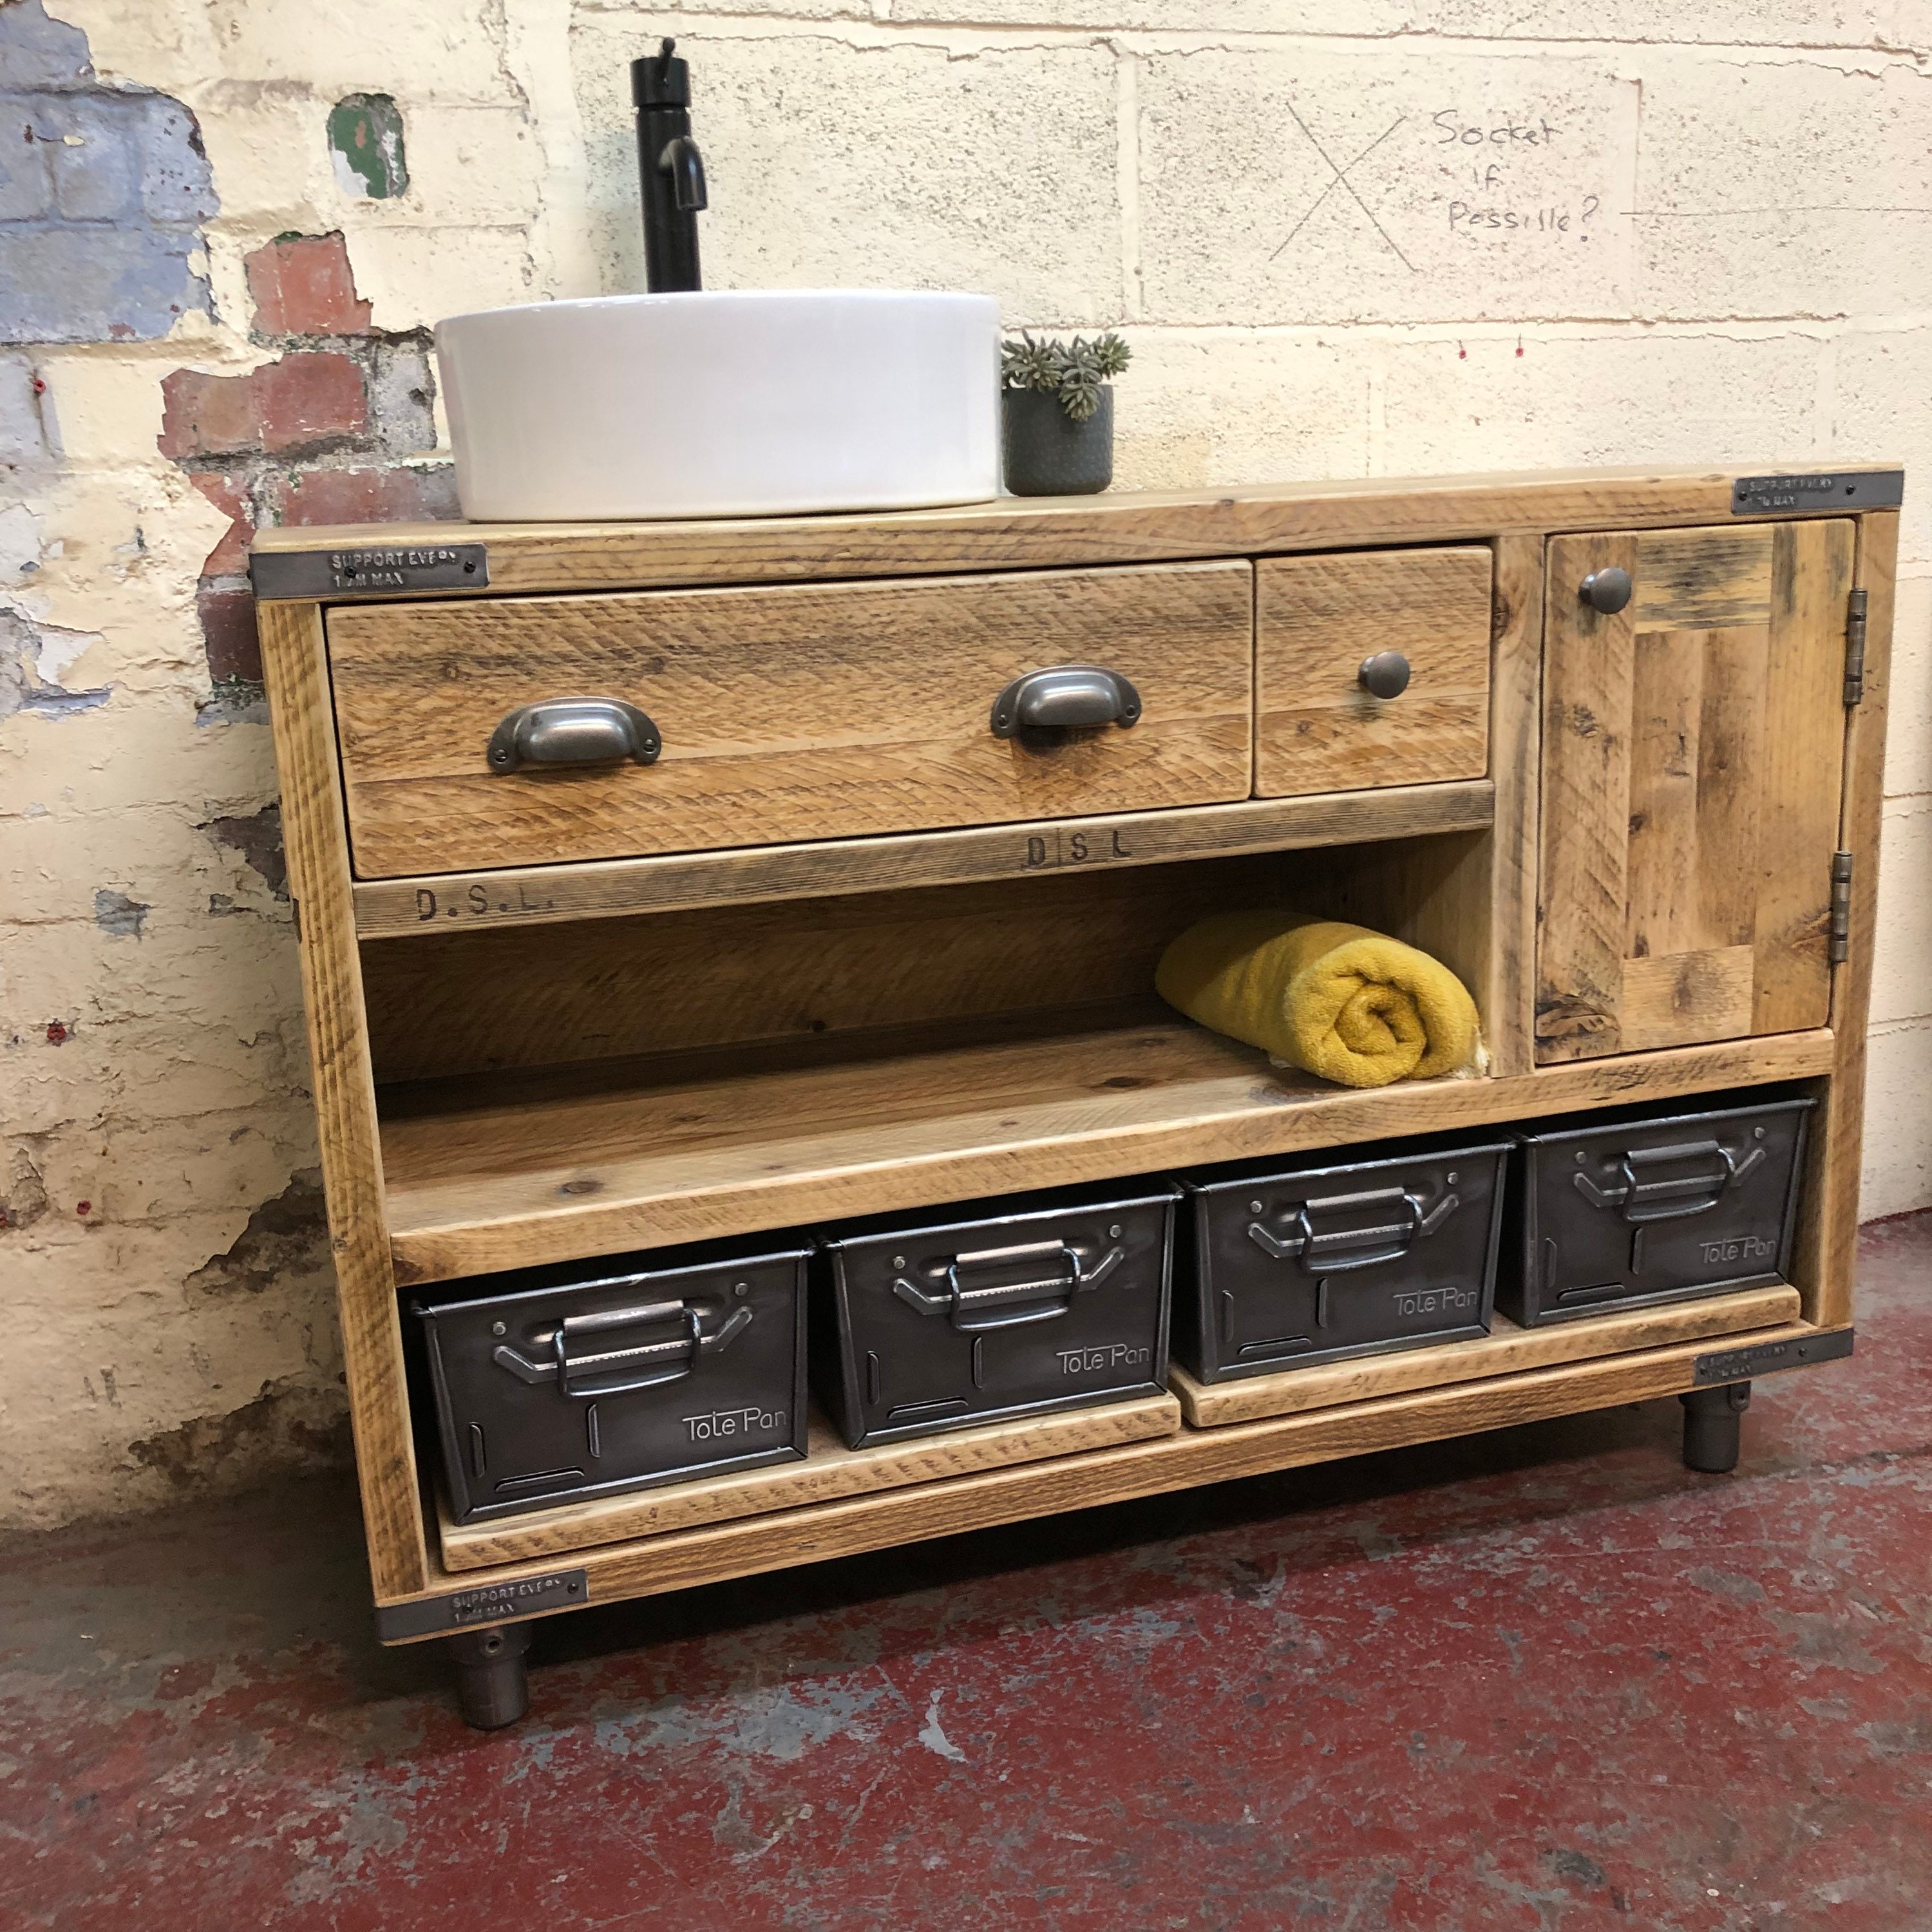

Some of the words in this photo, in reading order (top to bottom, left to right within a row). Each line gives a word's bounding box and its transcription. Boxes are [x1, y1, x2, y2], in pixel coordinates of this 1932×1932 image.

[1433, 109, 1564, 145] Socket
[331, 551, 404, 569] SUPPORT
[1700, 1238, 1739, 1264] Tote
[1743, 1236, 1777, 1258] Pan
[1393, 1289, 1436, 1316] Tote
[1443, 1287, 1477, 1309] Pan
[1056, 1346, 1104, 1374] Tote
[1111, 1343, 1150, 1367] Pan
[682, 1411, 736, 1441] Tote
[744, 1407, 786, 1432] Pan
[453, 1587, 515, 1608] SUPPORT
